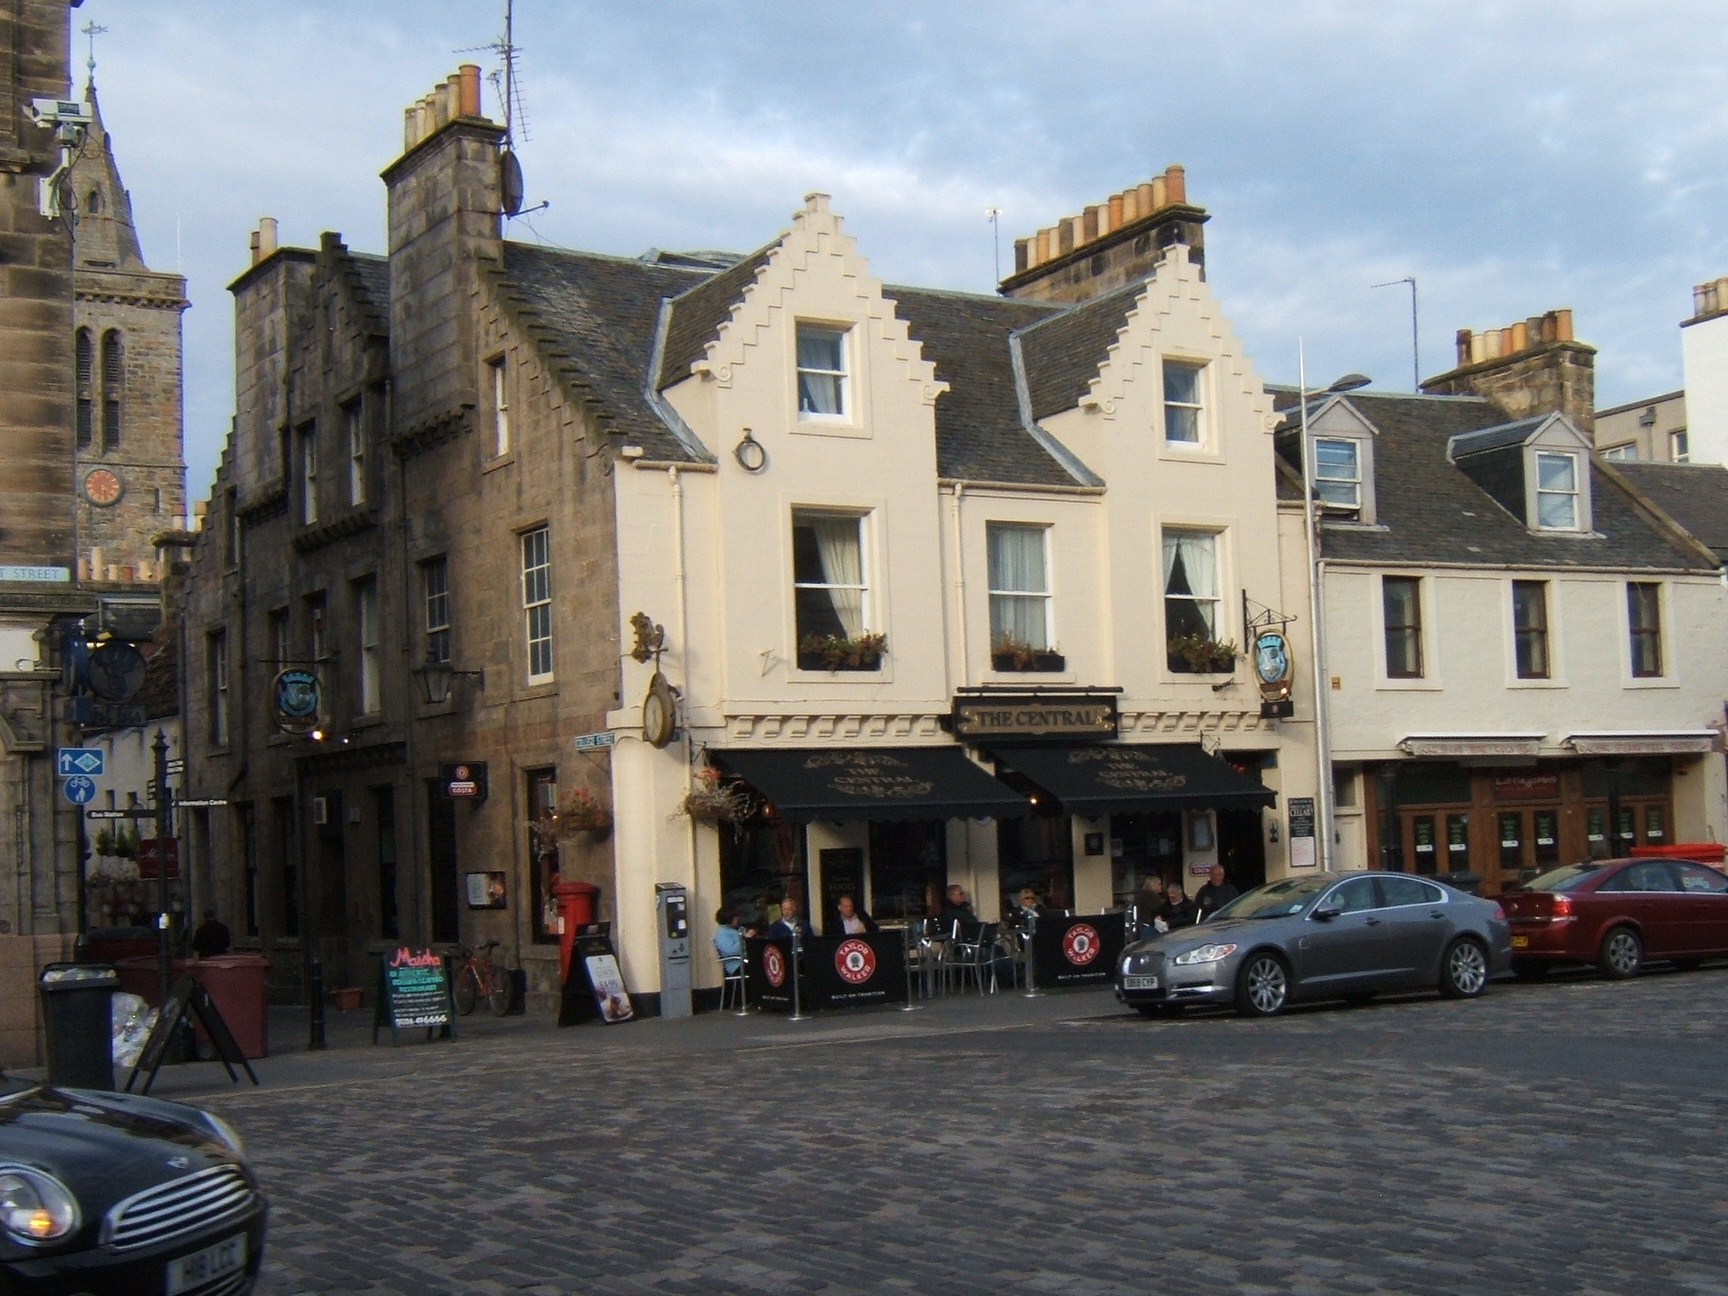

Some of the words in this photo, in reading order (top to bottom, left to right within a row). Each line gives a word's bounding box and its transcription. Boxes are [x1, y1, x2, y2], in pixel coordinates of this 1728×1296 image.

[13, 568, 58, 580] STREET
[976, 711, 1013, 728] THE
[1015, 710, 1095, 727] CENTRAL
[1068, 927, 1094, 939] TAYLOR
[839, 942, 869, 956] TAYLOR
[840, 965, 871, 981] WALKER
